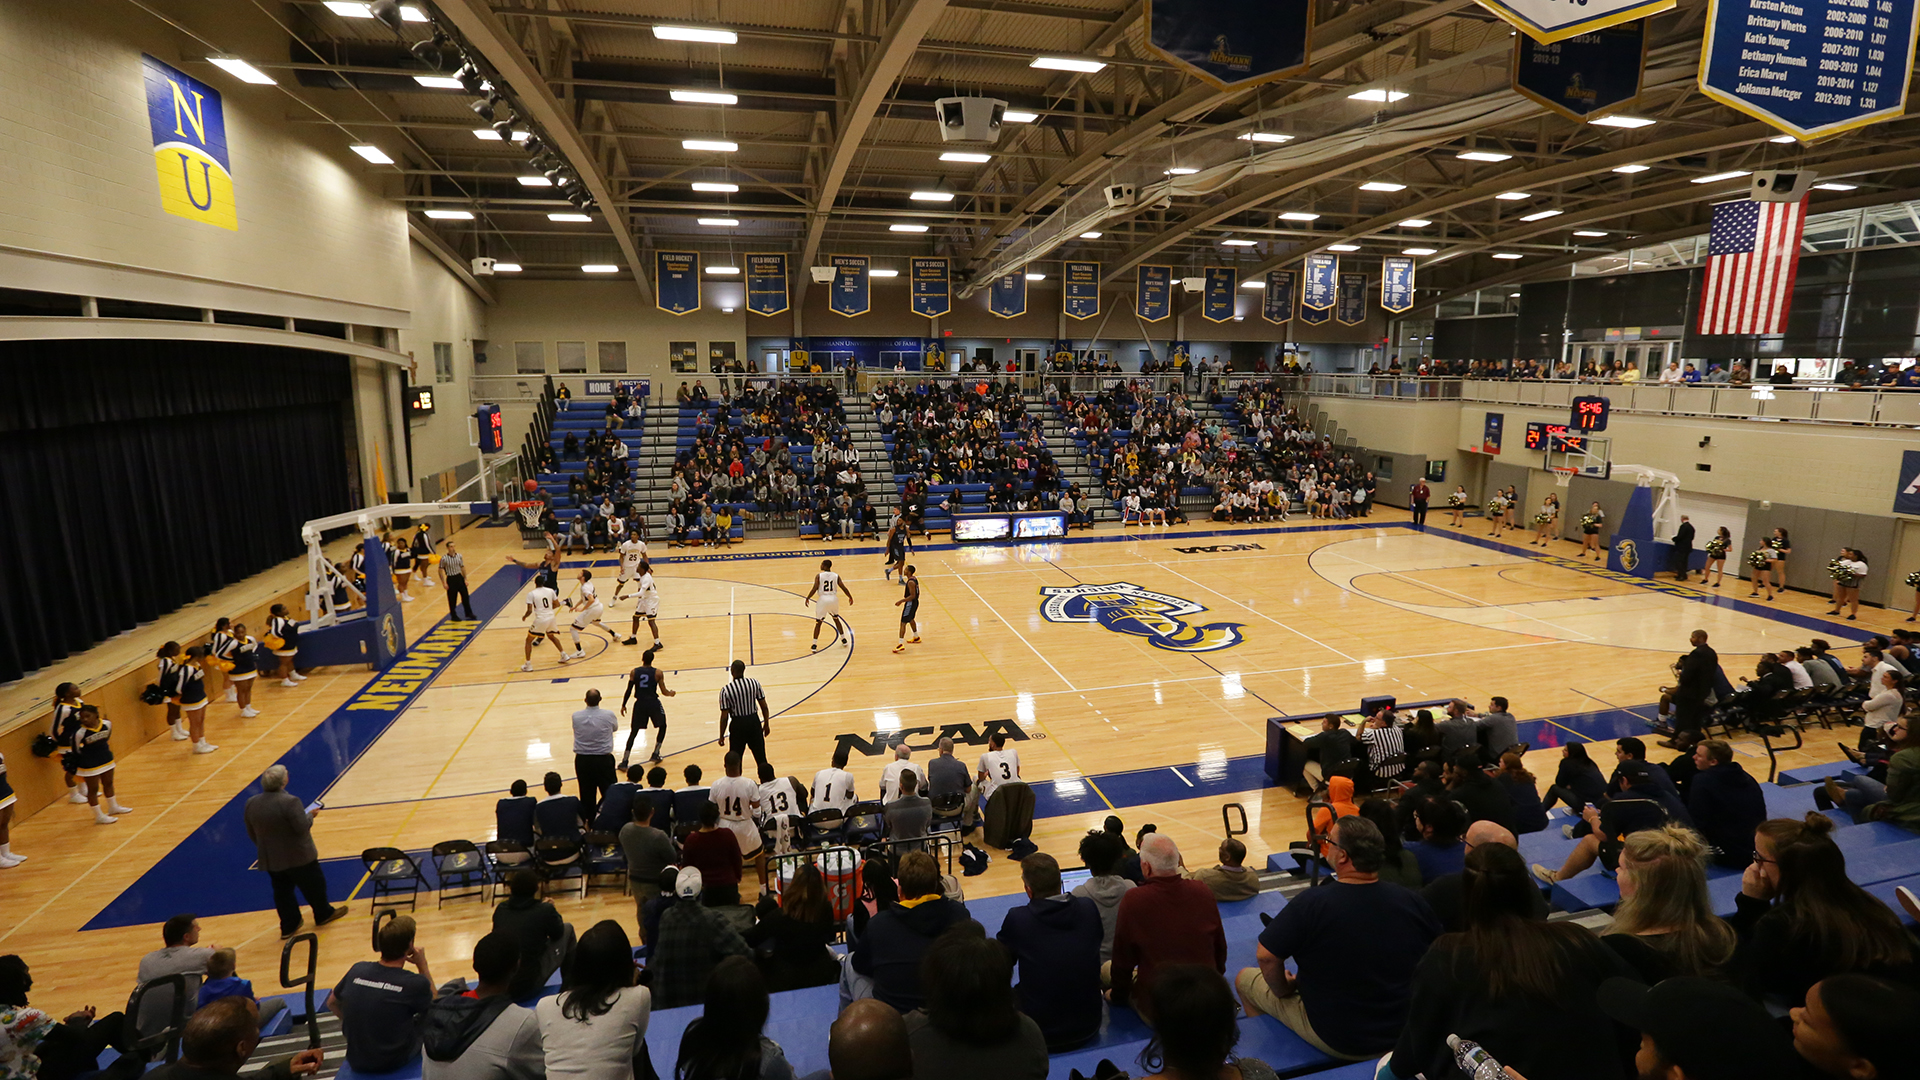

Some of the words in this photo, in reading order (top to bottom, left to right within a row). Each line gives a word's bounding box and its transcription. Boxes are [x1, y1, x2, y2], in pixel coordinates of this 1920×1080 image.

[1750, 0, 1779, 14] Kirsten
[1779, 3, 1804, 17] Patton
[1826, 9, 1867, 25] 2002-2006
[1873, 15, 1890, 29] 1,331
[1747, 15, 1781, 31] Brittany
[1781, 17, 1807, 34] Whetts
[1824, 26, 1864, 42] 2006-2010
[1744, 32, 1767, 44] Katie
[1768, 33, 1791, 50] Young
[1821, 43, 1860, 58] 2007-2011
[1533, 53, 1560, 65] 2012-13
[1741, 49, 1775, 65] Bethany
[1775, 52, 1808, 68] Humenik
[1819, 59, 1858, 74] 2009-2013
[1865, 65, 1882, 78] 1,044
[1738, 66, 1760, 79] Erica
[1760, 68, 1788, 82] Marvel
[1817, 75, 1854, 90] 2010-2014
[1862, 81, 1879, 94] 1,127
[1735, 82, 1770, 97] JoHanna
[1770, 84, 1803, 102] Metzger
[1814, 92, 1852, 106] 2012-2016
[1859, 97, 1877, 109] 1,331
[167, 79, 206, 146] N
[178, 152, 212, 212] U
[795, 341, 803, 349] N
[795, 351, 803, 360] U
[589, 382, 611, 393] HOME
[1579, 401, 1603, 414] 5:46
[1582, 414, 1596, 428] 11
[1527, 430, 1540, 442] 24
[628, 553, 638, 562] 25
[1172, 543, 1267, 554] NCAA
[823, 580, 834, 592] 21
[542, 597, 549, 608] 0
[345, 620, 483, 711] NEUMANN
[640, 674, 649, 688] 2
[832, 718, 1031, 757] NCAA
[1000, 762, 1011, 780] 3
[823, 783, 832, 802] 1
[724, 796, 742, 816] 14
[769, 791, 789, 814] 13
